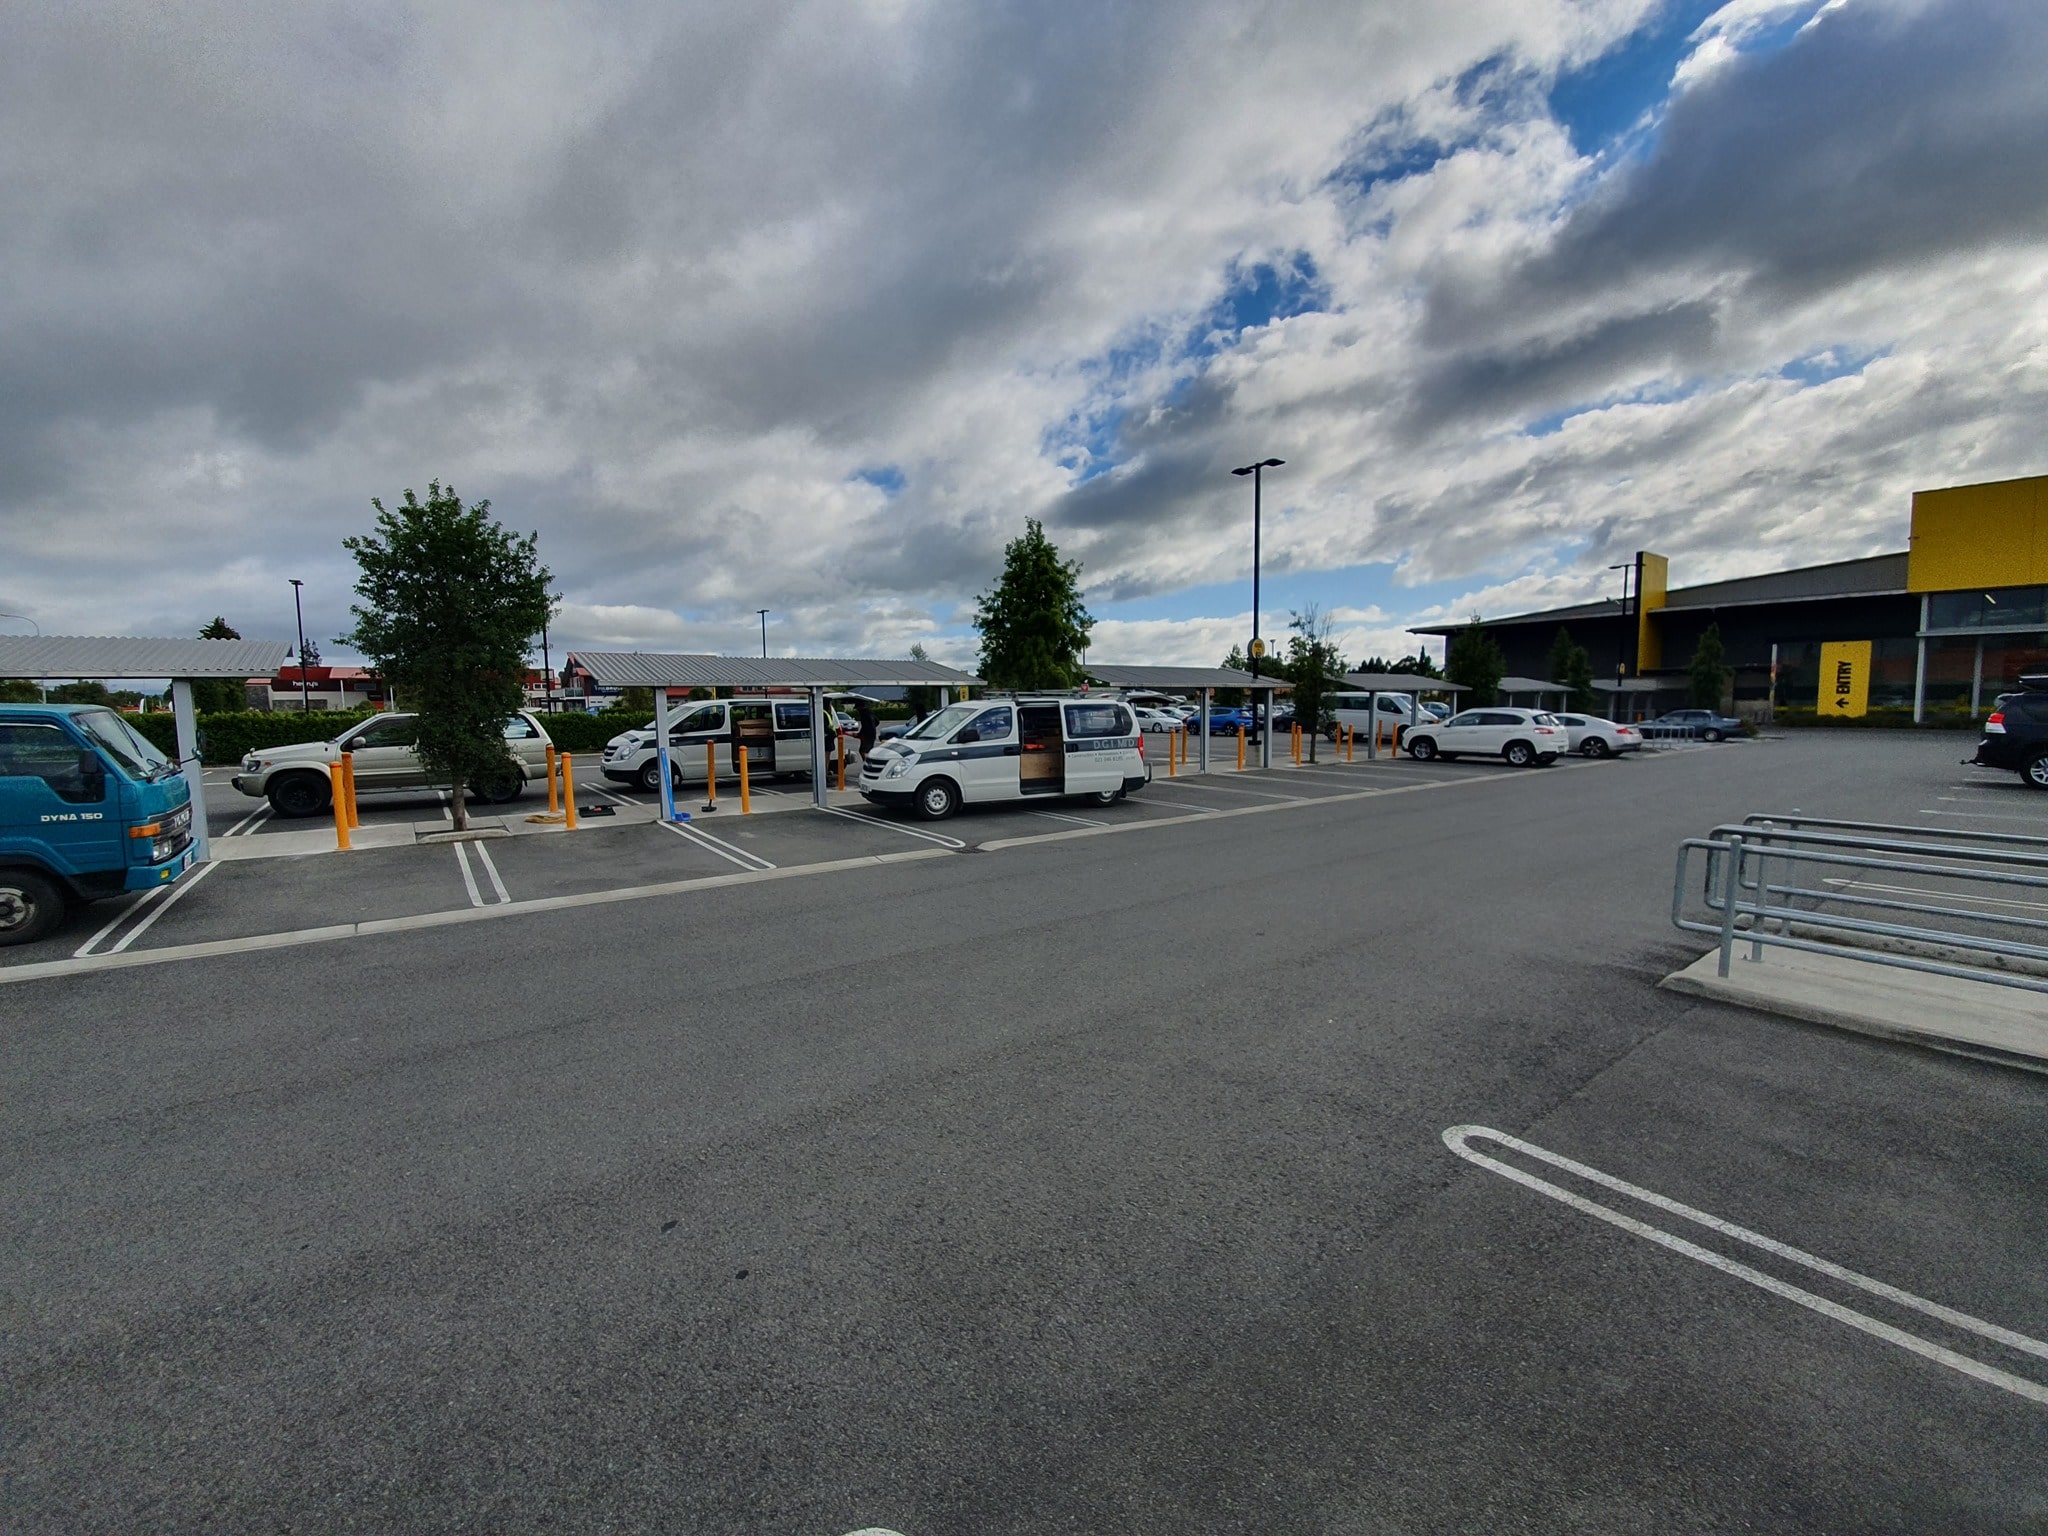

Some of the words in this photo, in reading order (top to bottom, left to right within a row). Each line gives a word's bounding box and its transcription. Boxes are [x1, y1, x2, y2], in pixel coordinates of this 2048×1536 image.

[1836, 661, 1852, 694] ENTRY
[41, 813, 77, 822] DYNA
[80, 812, 103, 820] 150
